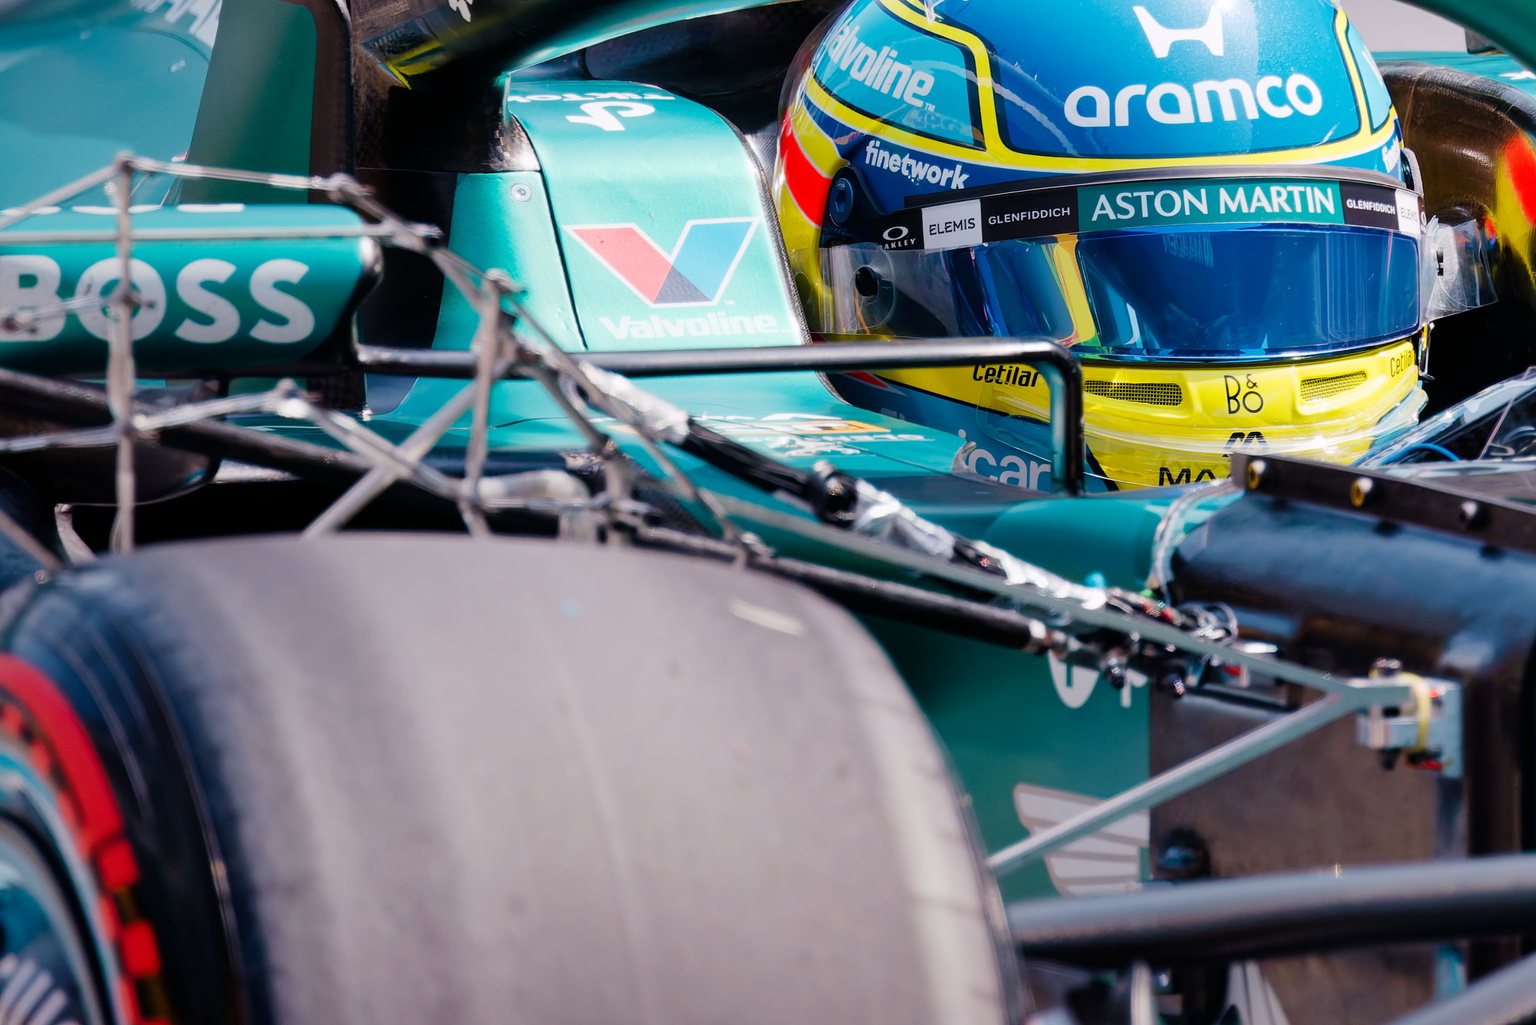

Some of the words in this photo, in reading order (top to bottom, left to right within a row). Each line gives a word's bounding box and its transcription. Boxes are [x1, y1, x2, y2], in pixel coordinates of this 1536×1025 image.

[1063, 73, 1323, 128] aramco
[864, 139, 970, 190] finetwork
[987, 206, 1071, 226] GLENFIDDICH
[1091, 187, 1209, 222] ASTON
[1218, 185, 1336, 215] MARTIN
[1346, 198, 1396, 215] GLENFIDDICH
[928, 217, 977, 236] ELEMIS
[0, 254, 316, 344] BOSS
[598, 311, 778, 340] Valvoline
[972, 362, 1042, 388] Cetilar
